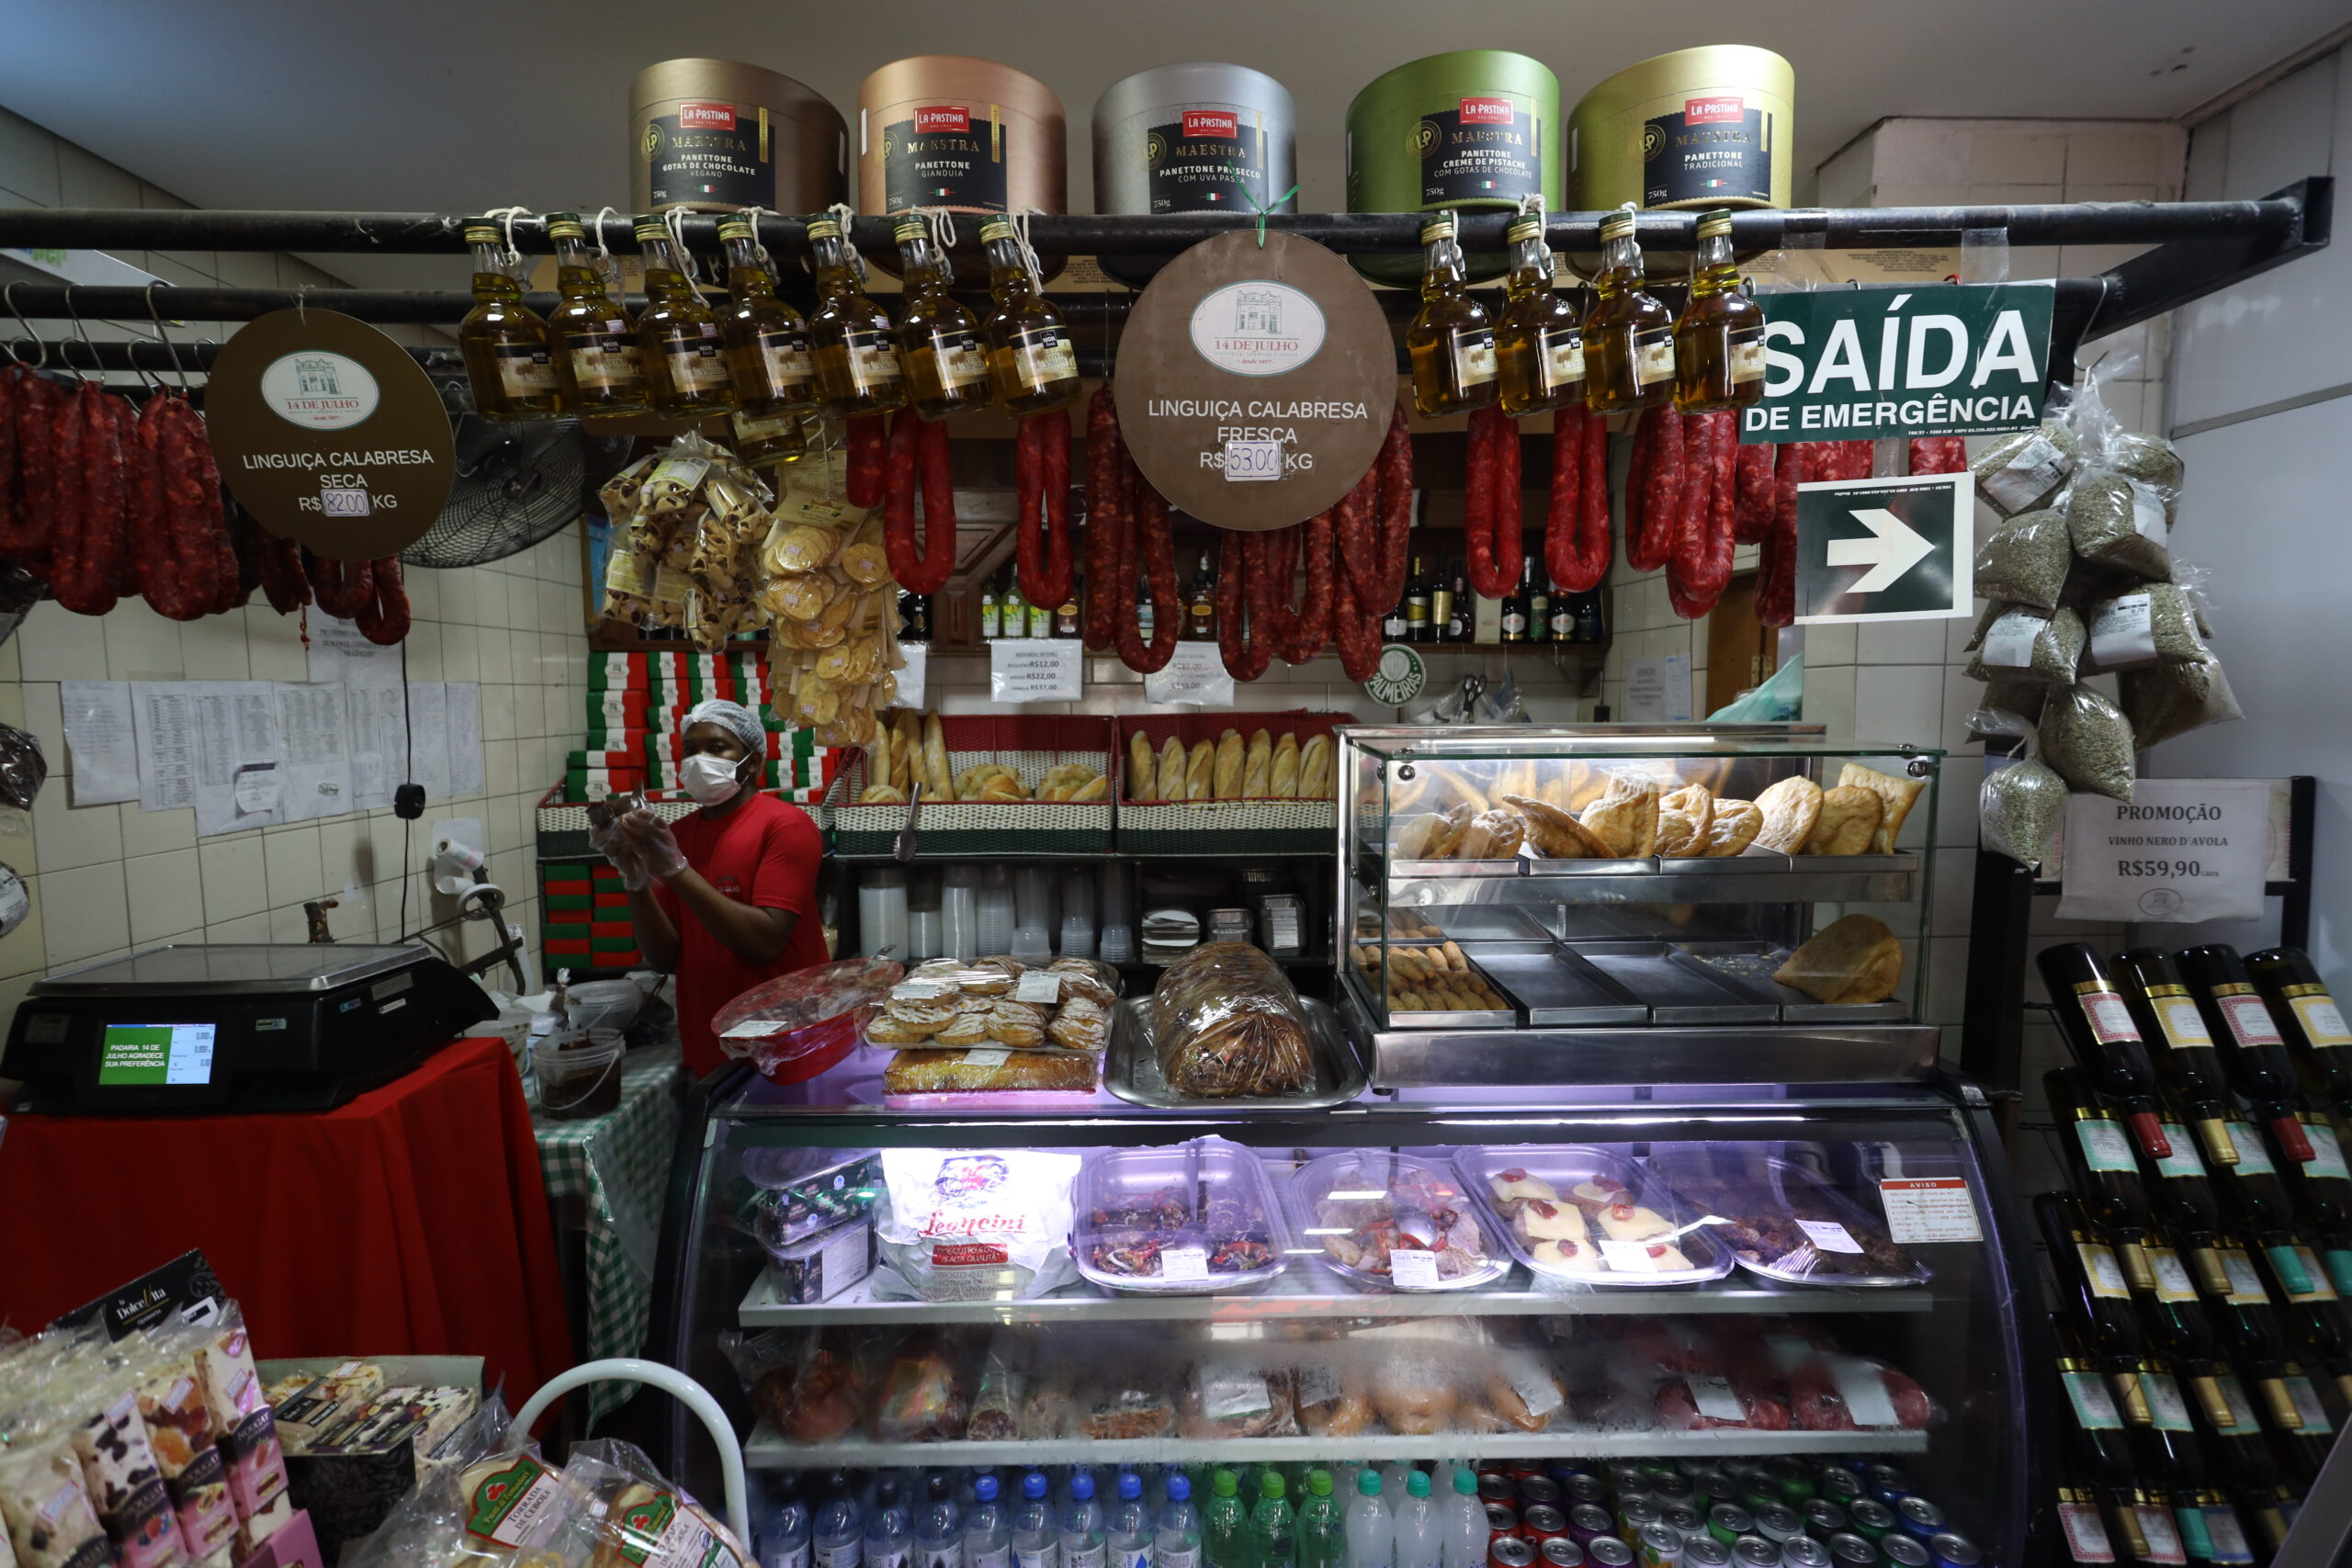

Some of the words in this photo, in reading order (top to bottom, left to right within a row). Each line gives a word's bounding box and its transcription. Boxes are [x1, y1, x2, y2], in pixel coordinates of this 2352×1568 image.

[684, 110, 694, 119] LA
[695, 108, 729, 120] PASTINA
[1466, 105, 1476, 115] LA
[1477, 104, 1510, 115] PASTINA
[1691, 106, 1702, 116] LA
[1704, 103, 1739, 114] PASTINA
[919, 114, 929, 124] LA
[931, 113, 964, 123] PASTINA
[1189, 118, 1197, 128] LA
[1200, 117, 1233, 129] PASTINA
[1452, 131, 1522, 145] MAESTRA
[1675, 130, 1750, 147] MAESTRA
[1176, 144, 1246, 158] MAESTRA
[1462, 150, 1511, 158] PANETTONE
[1684, 152, 1743, 163] PANETTONE
[681, 153, 732, 163] PANETTONE
[1443, 158, 1473, 168] CREME
[1488, 158, 1526, 169] PISTACHE
[662, 162, 686, 172] GOTAS
[703, 163, 755, 175] CHOCOLATE
[915, 161, 970, 170] PANETTONE
[1159, 165, 1214, 176] PANETTONE
[1684, 160, 1743, 171] TRADICIONAL
[690, 170, 722, 178] VEGANO
[1178, 175, 1196, 183] COM
[1434, 167, 1452, 177] COM
[1454, 166, 1479, 175] GOTAS
[1494, 166, 1532, 179] CHOCOLATE
[1426, 187, 1444, 197] 750g
[1647, 189, 1668, 199] 750g
[1215, 340, 1228, 349] 14
[1233, 341, 1251, 350] DE
[1253, 341, 1299, 353] JULHO
[1763, 293, 2039, 398] SAÍDA
[287, 401, 300, 411] 14
[302, 400, 319, 410] DE
[320, 400, 359, 411] JULHO
[1148, 400, 1243, 422] LINGUIÇA
[1248, 401, 1368, 419] CALABRESA
[1746, 406, 1790, 432] DE
[1801, 392, 2035, 429] EMERGÊNCIA
[1217, 427, 1298, 444] FRESCA
[243, 453, 327, 471] LINGUIÇA
[329, 449, 435, 467] CALABRESA
[1200, 452, 1225, 469] R$
[1285, 453, 1313, 469] KG
[320, 473, 368, 489] SECA
[299, 496, 322, 512] R$
[372, 494, 398, 508] KG
[1027, 672, 1056, 681] R$22,00
[1370, 671, 1421, 703] PALMEIRAS
[2117, 804, 2222, 824] PROMOÇÃO
[2108, 837, 2143, 846] VINHO
[2146, 837, 2177, 846] NERO
[2118, 860, 2200, 879] R$59,90
[920, 1209, 1026, 1237] Leoncini
[507, 1486, 542, 1522] TORRADA
[514, 1519, 526, 1529] DE
[524, 1490, 551, 1518] CEBOLA
